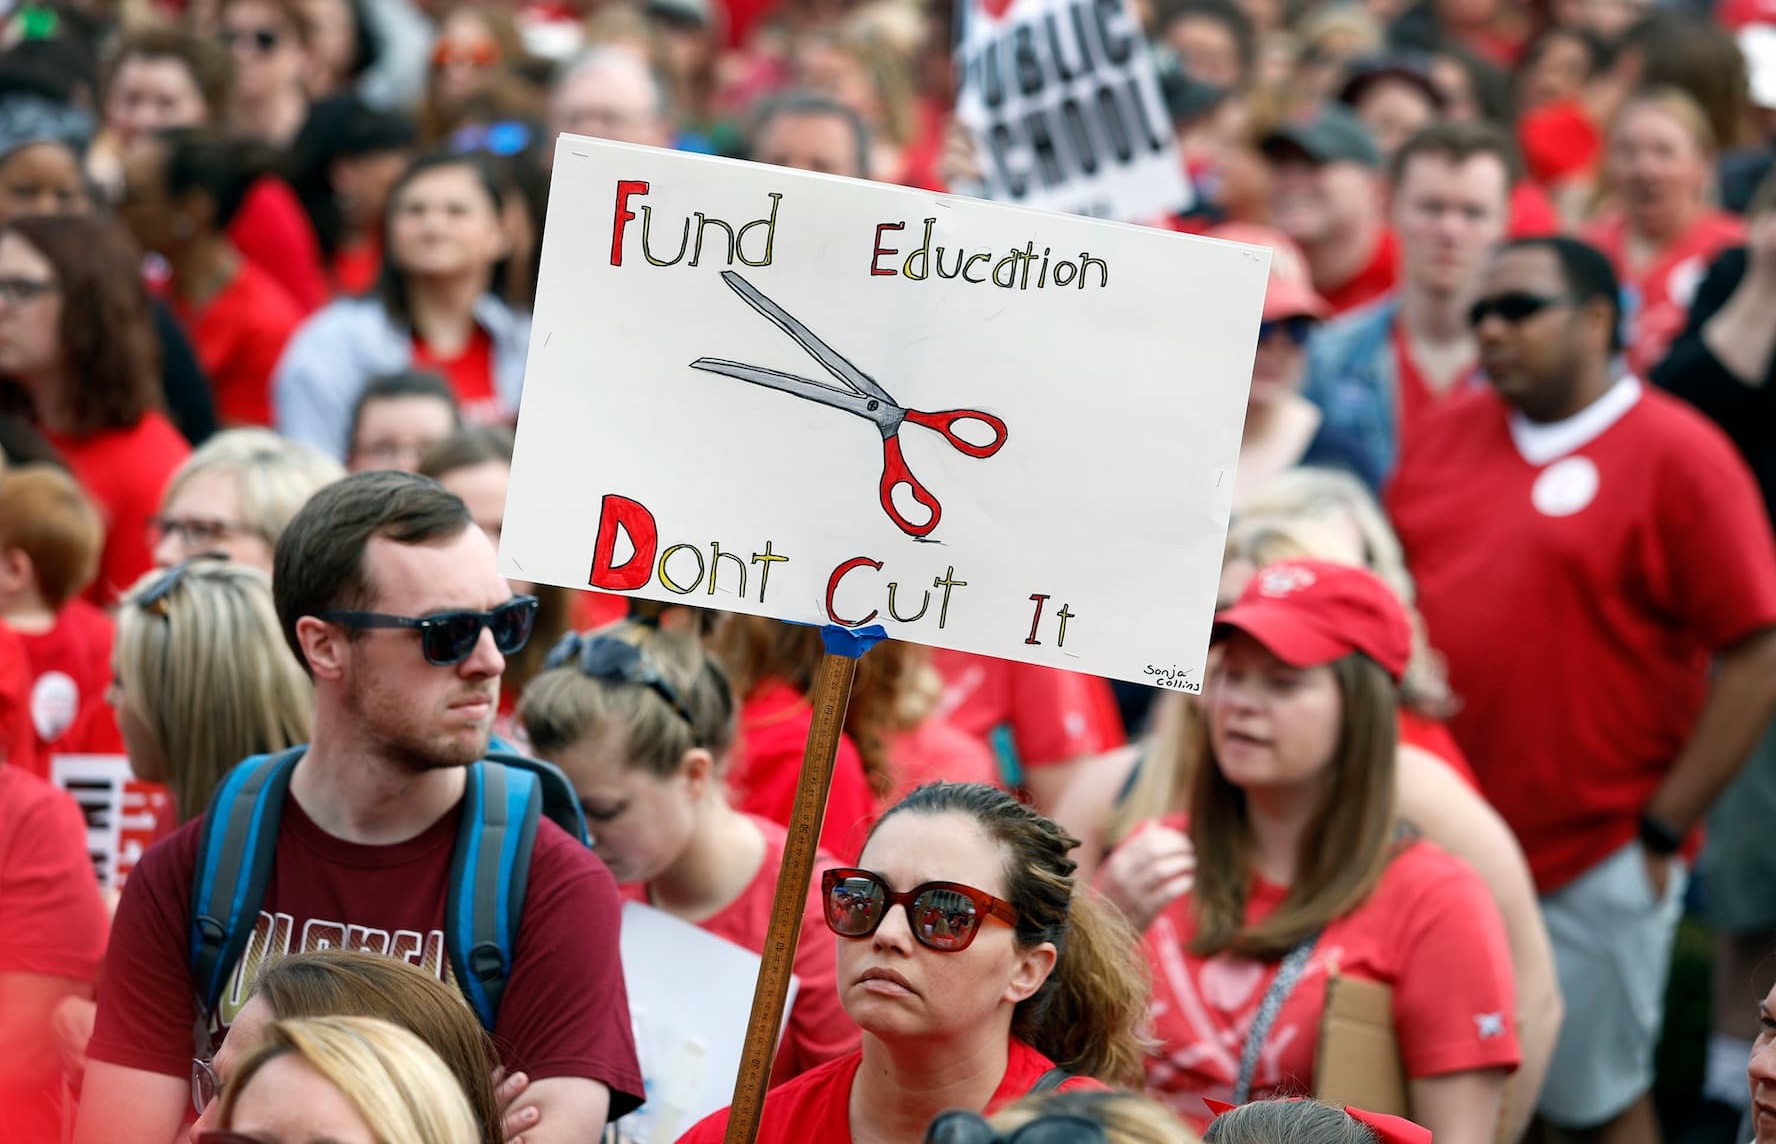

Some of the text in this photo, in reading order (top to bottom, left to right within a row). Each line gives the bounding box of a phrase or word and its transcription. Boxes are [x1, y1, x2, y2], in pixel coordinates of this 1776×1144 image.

[610, 180, 1108, 290] Fund Education
[589, 494, 1076, 648] Dont Cut It
[1143, 664, 1192, 680] Sonja
[1156, 678, 1200, 691] Collins
